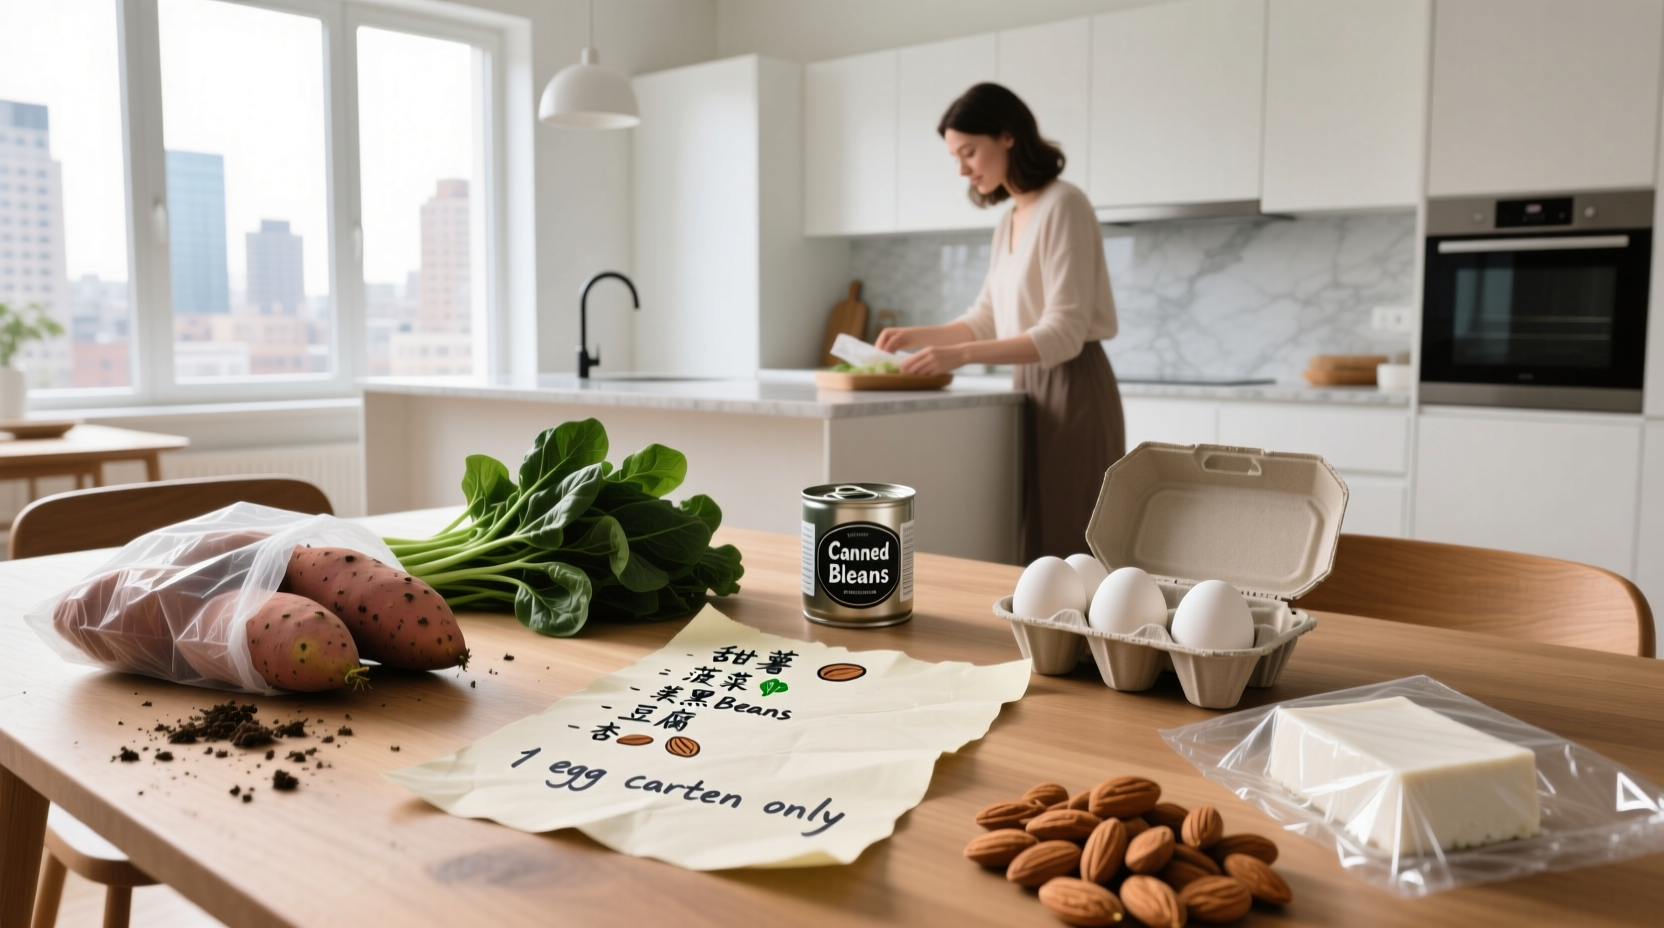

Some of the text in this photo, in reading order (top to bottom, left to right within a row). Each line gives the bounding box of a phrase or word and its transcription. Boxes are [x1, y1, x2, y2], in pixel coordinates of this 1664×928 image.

[828, 540, 889, 561] Canned
[828, 563, 889, 584] Bleans
[510, 747, 846, 837] 1 egg carten only
